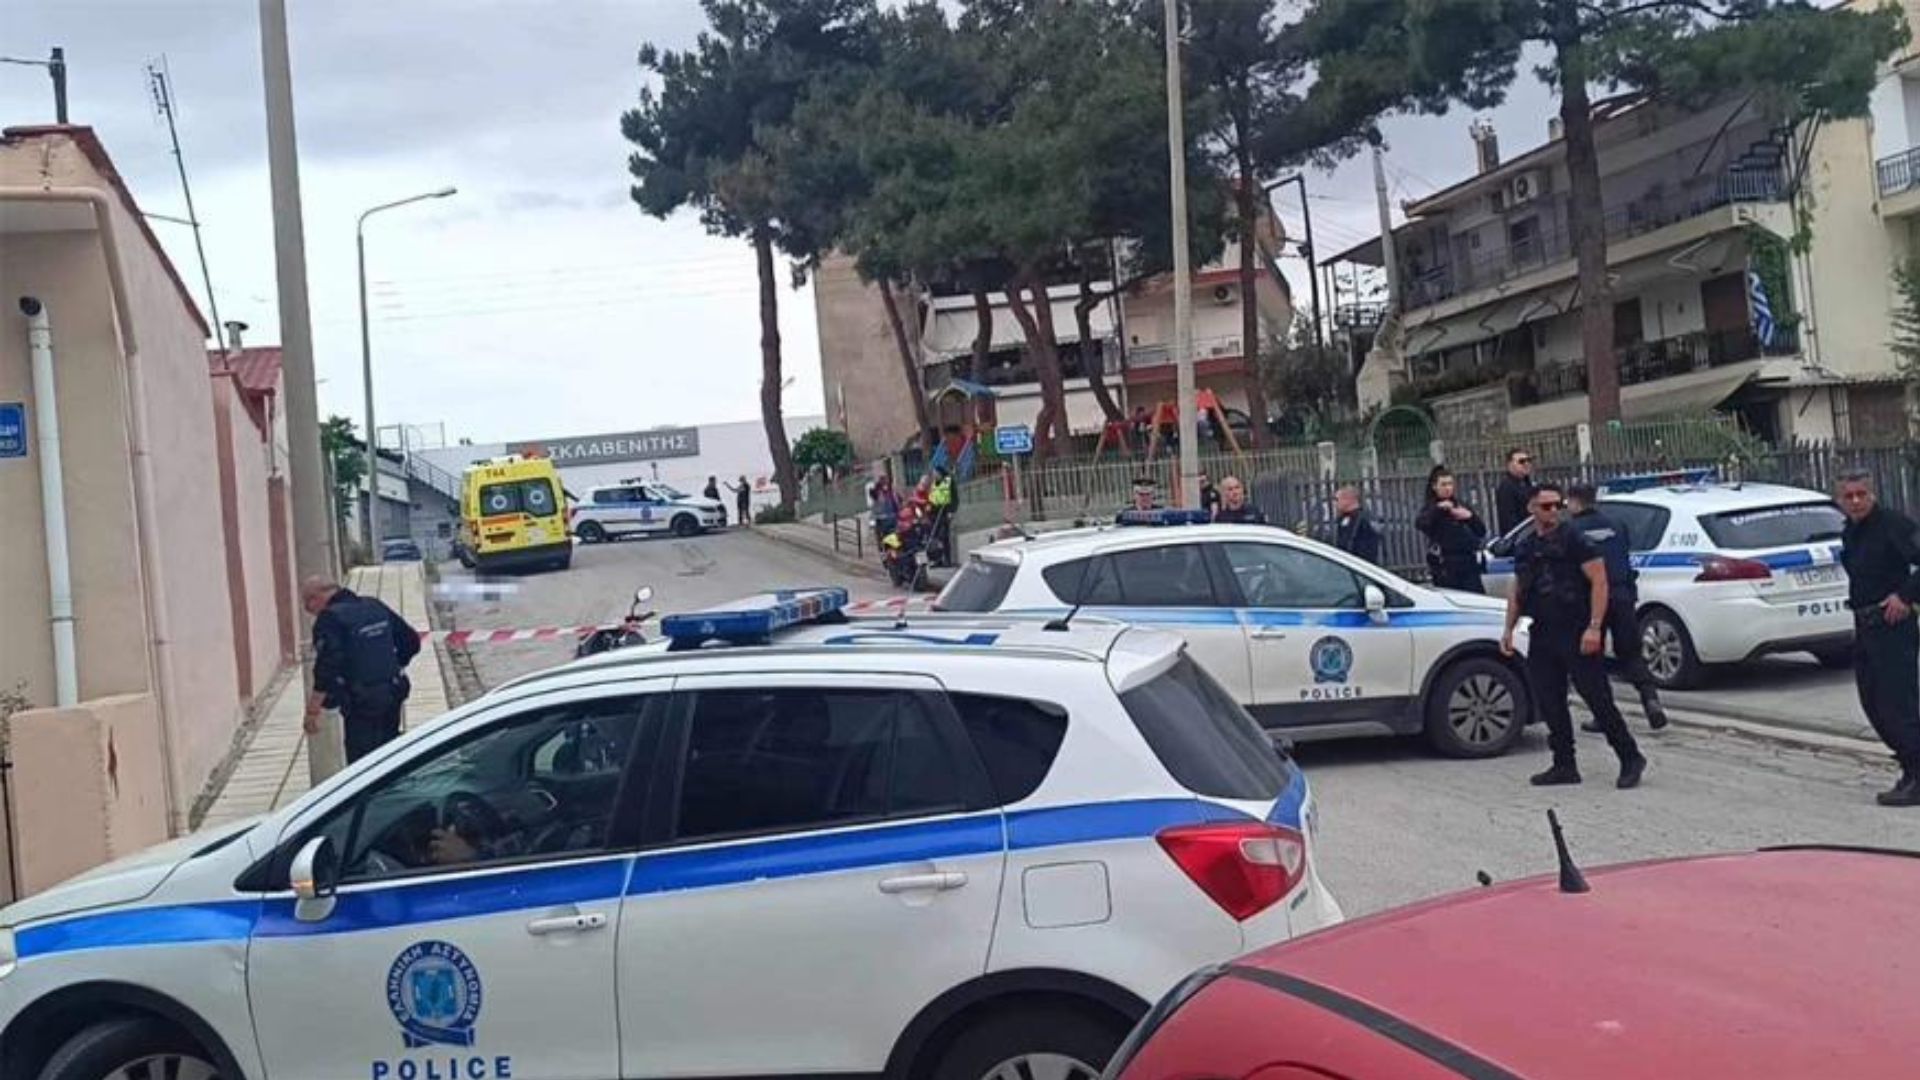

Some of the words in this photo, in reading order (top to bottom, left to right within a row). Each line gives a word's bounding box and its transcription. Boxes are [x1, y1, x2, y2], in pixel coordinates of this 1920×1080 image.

[547, 435, 688, 460] ΣΚΛΑΒΕΝΙΤΗΣ
[1300, 686, 1362, 699] POLICE
[389, 946, 423, 1021] ΕΛΛΗΝΙΚΗ
[431, 943, 479, 1020] ΑΣΤΥΝΟΜΙΑ
[372, 1056, 512, 1080] POLICE
